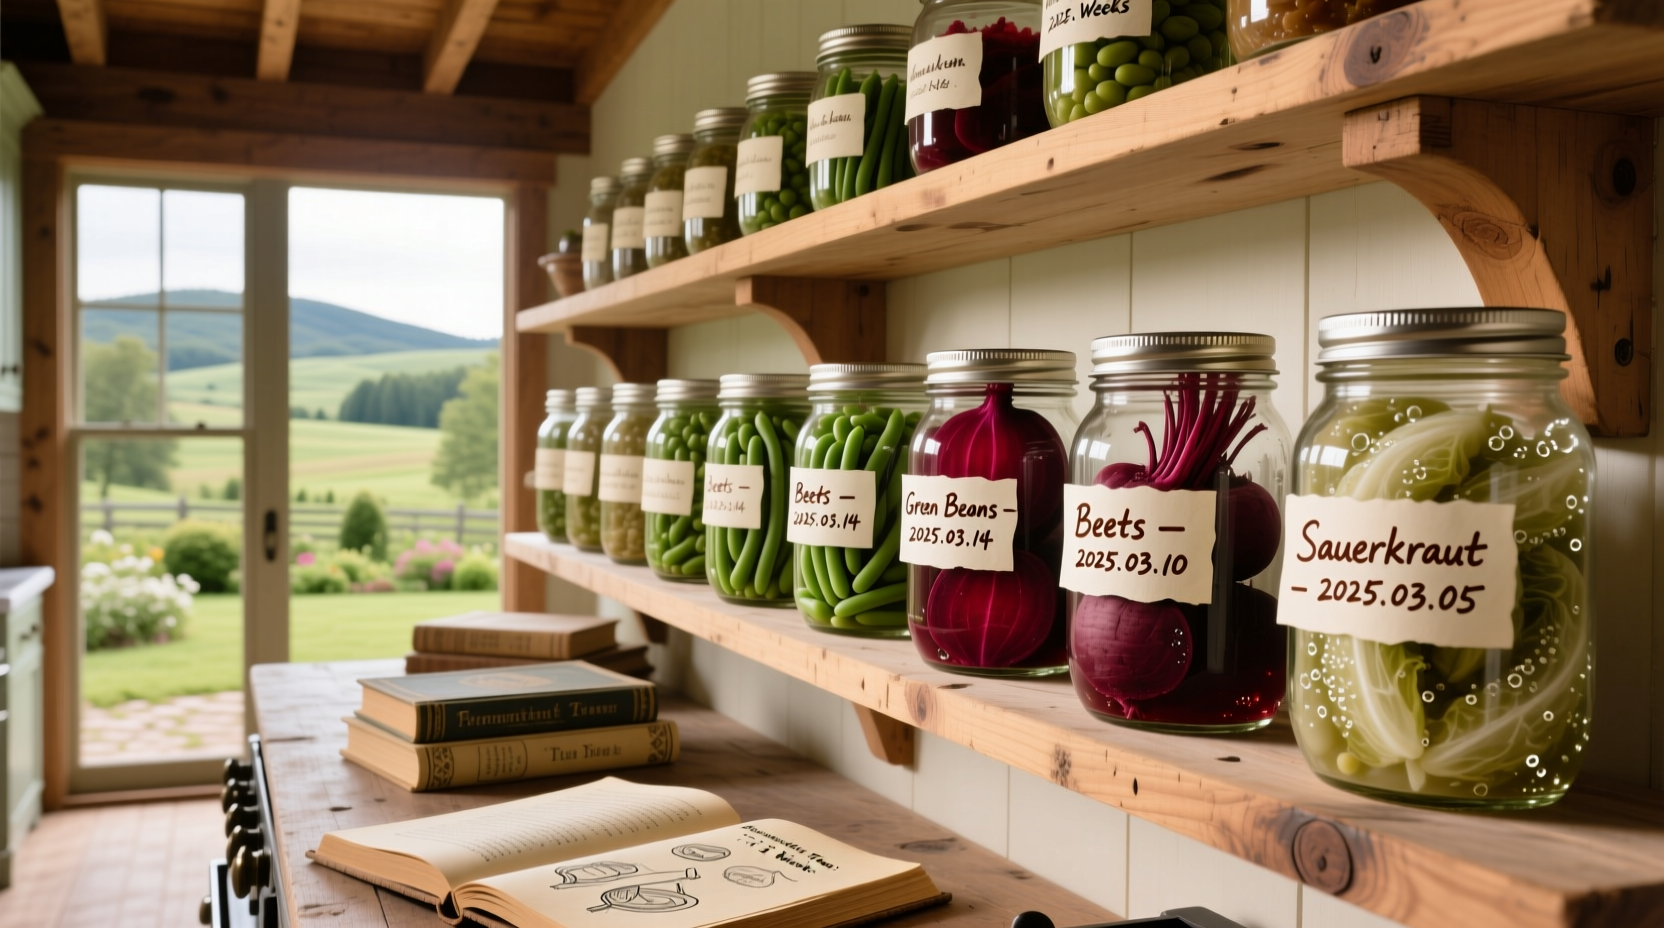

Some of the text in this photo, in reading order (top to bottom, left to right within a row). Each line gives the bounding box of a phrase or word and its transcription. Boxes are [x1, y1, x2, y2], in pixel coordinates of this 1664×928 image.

[794, 481, 831, 505] Beets
[944, 492, 997, 519] Beans
[1075, 502, 1146, 540] Beets
[909, 526, 994, 551] 2025.03.14
[1297, 519, 1488, 567] Sauerkraut
[1075, 549, 1188, 576] 2025.03.10
[1317, 577, 1485, 614] 2025.03.05
